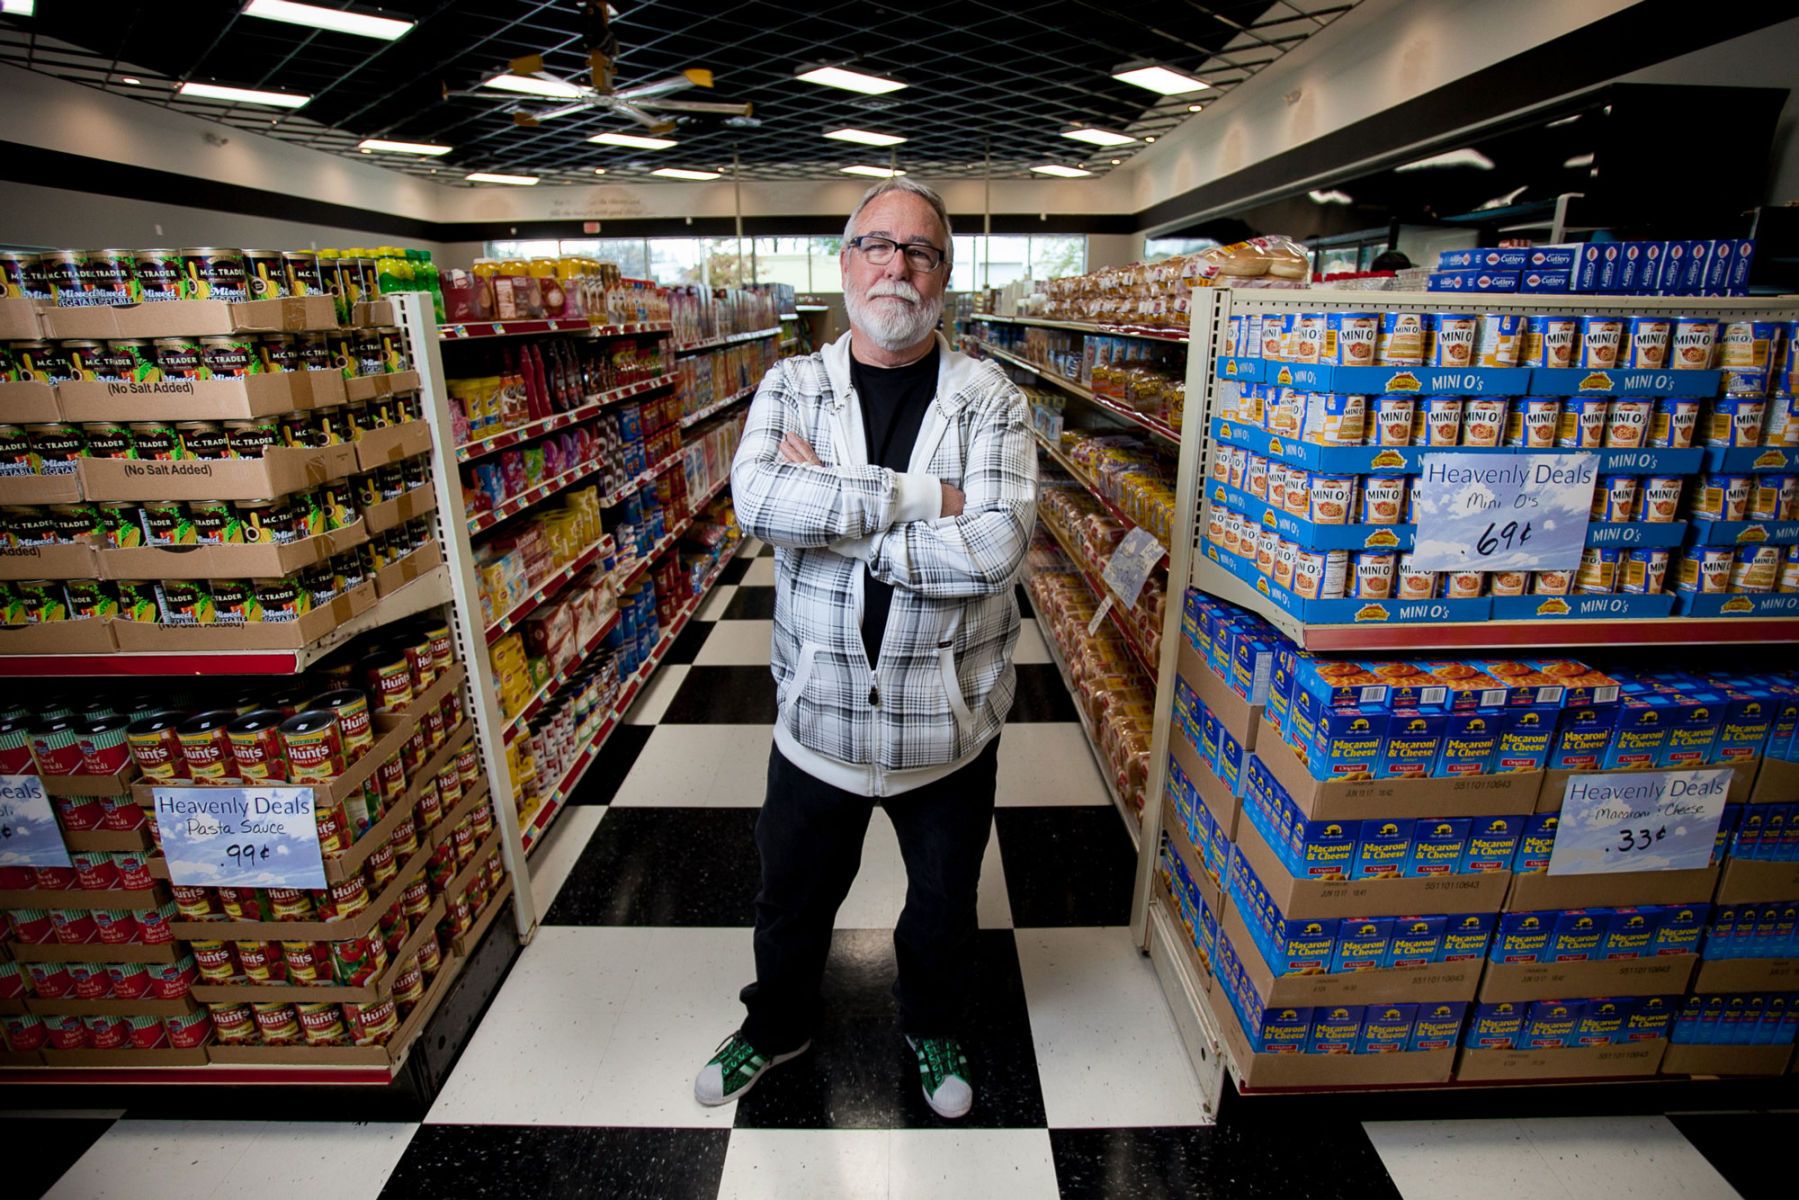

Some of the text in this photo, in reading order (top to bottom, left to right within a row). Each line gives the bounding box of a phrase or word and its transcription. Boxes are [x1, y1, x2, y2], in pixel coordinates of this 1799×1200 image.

[1500, 254, 1526, 264] Cutlery
[1546, 254, 1570, 264] Cutlery
[143, 269, 177, 278] TRADER
[1491, 277, 1516, 287] Cutlery
[1541, 276, 1567, 286] Cutlery
[1341, 331, 1365, 341] MINI
[1441, 332, 1466, 343] MINI
[1547, 333, 1568, 344] MINI
[1587, 333, 1612, 344] MINI
[1637, 334, 1660, 345] MINI
[1674, 333, 1702, 345] MINI
[166, 356, 198, 365] TRADER
[219, 355, 247, 364] TRADER
[1432, 374, 1484, 391] MINI O's
[1624, 374, 1675, 391] MINI O's
[108, 381, 194, 397] (No Salt Added)
[1380, 412, 1404, 423] MINI
[1430, 411, 1453, 423] MINI
[1463, 411, 1487, 422] MINI
[1528, 412, 1551, 424] MINI
[1606, 413, 1631, 423] MINI
[1736, 414, 1759, 425] MINI
[0, 442, 28, 450] RADER
[45, 440, 79, 450] TRADER
[92, 439, 124, 449] TRADER
[138, 440, 168, 449] TRADER
[202, 438, 228, 447] TRADE
[243, 436, 273, 446] TRADER
[1608, 454, 1658, 469] MINI O's
[124, 463, 212, 477] (No Salt Added)
[1428, 463, 1592, 488] Heavenly Deals
[1312, 490, 1334, 500] MINI
[1367, 490, 1390, 500] MINI
[1649, 489, 1672, 500] MINI
[1466, 492, 1539, 509] Mini O's
[59, 520, 90, 529] TRADER
[1593, 527, 1642, 543] MINI O's
[1359, 565, 1381, 575] MINI
[1703, 561, 1725, 572] MINI
[265, 590, 294, 601] TRADER
[1580, 599, 1629, 614] MINI O's
[1760, 599, 1785, 611] MINI
[1400, 605, 1450, 620] MINI O's
[1502, 733, 1549, 743] Macaroni
[1564, 729, 1609, 741] Macaroni
[1673, 727, 1715, 738] Macaroni
[1333, 738, 1380, 749] Macaroni
[1391, 738, 1437, 749] Macaroni
[1448, 738, 1494, 749] Macaroni
[1500, 742, 1545, 751] & Cheese
[1573, 740, 1606, 750] Cheese
[1680, 737, 1712, 747] Cheese
[1331, 748, 1377, 757] & Cheese
[1388, 748, 1434, 757] & Cheese
[1446, 748, 1491, 757] & Cheese
[0, 783, 42, 799] eals
[1570, 778, 1724, 801] Heavenly Deals
[159, 796, 310, 817] Heavenly Deals
[1595, 807, 1651, 820] Macaroni
[1664, 803, 1705, 816] Cheese
[187, 818, 286, 835] Pasta Sauce
[1307, 842, 1353, 853] Macaroni
[1472, 837, 1515, 848] Macaroni
[1317, 851, 1350, 861] Cheese
[1481, 847, 1512, 856] Cheese
